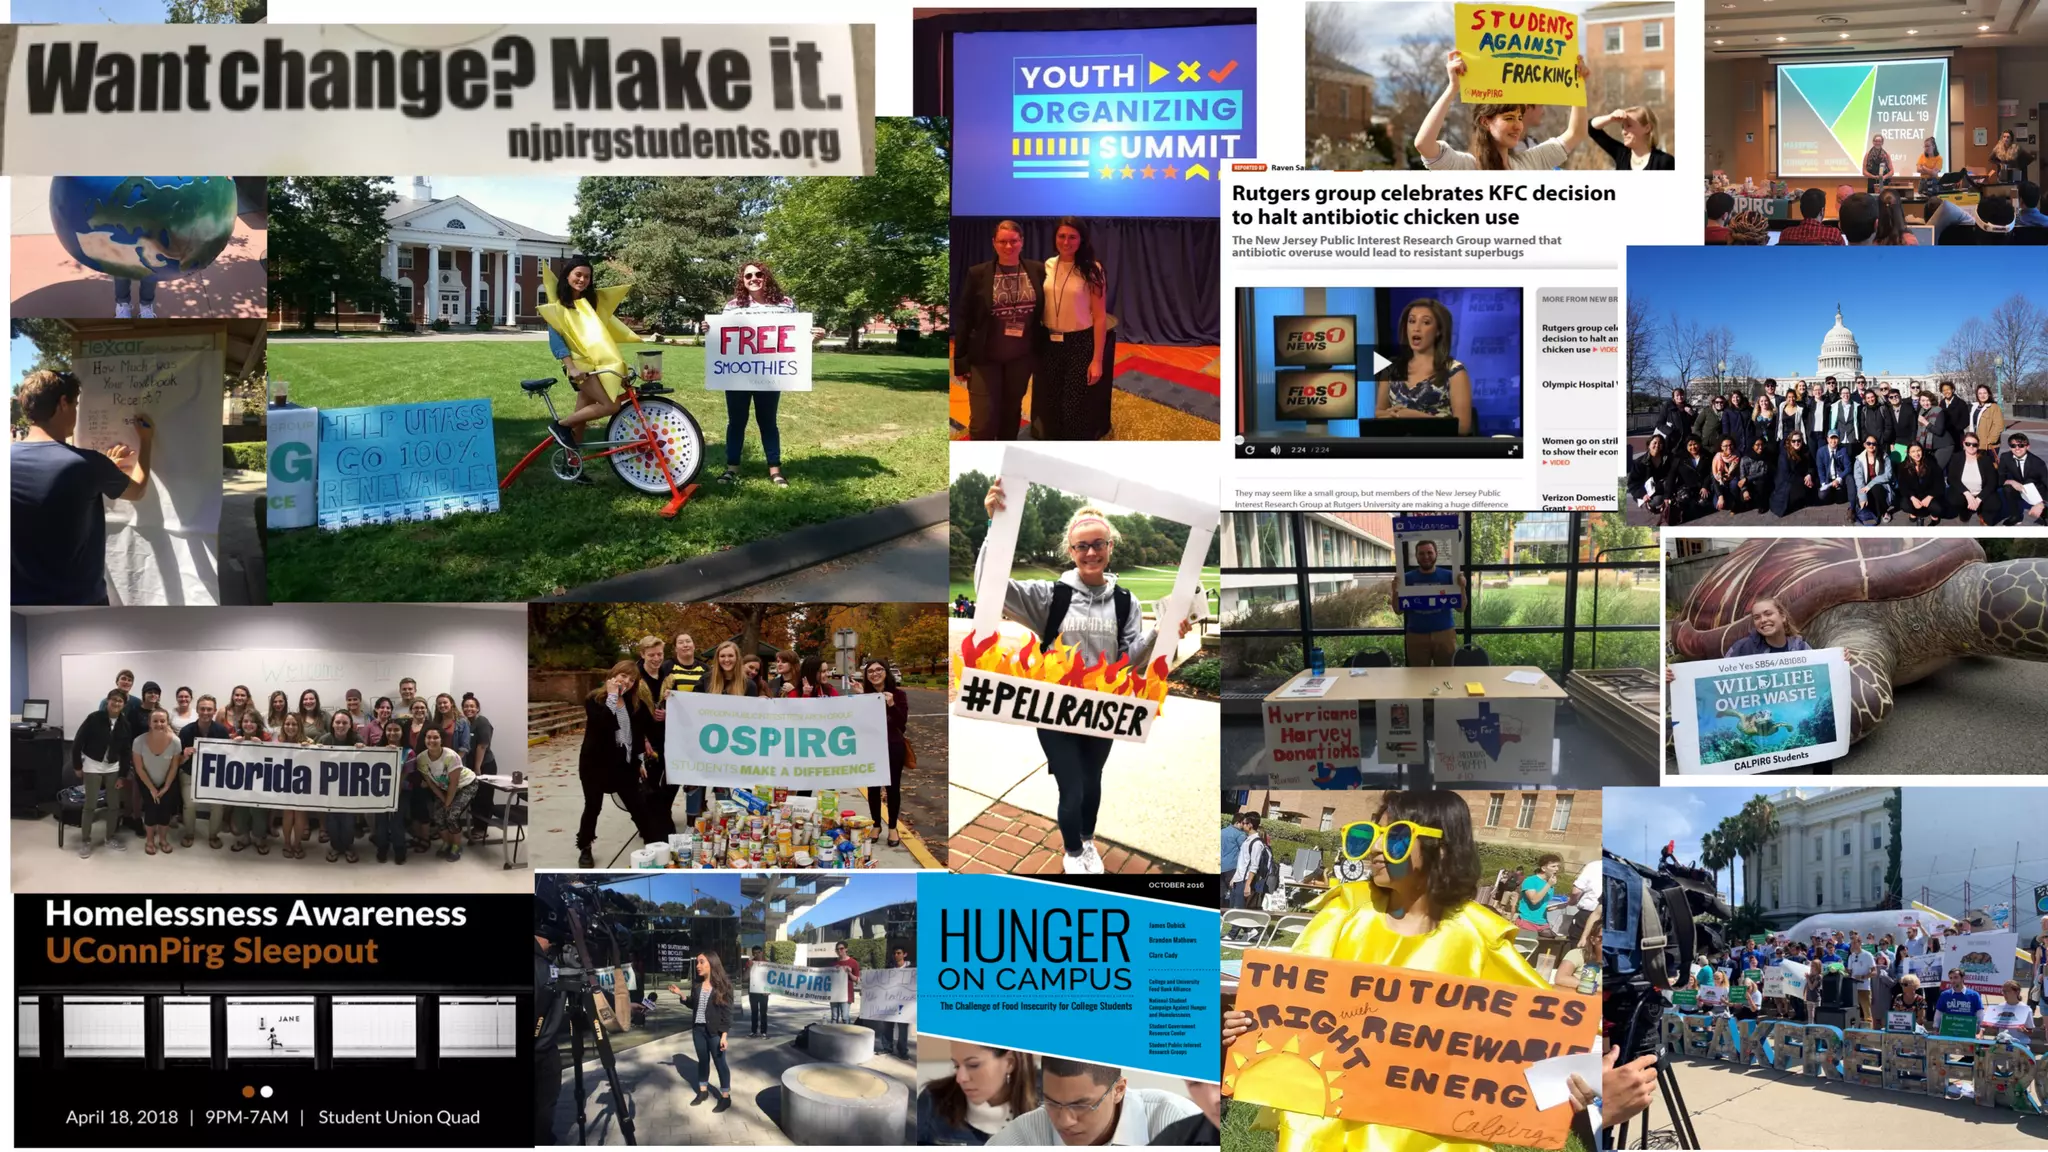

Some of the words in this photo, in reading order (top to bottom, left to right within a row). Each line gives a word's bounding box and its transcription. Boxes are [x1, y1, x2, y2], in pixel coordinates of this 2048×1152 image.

[1471, 9, 1574, 41] STUDENTS
[1479, 32, 1566, 56] AGAINST
[27, 42, 211, 115] Want
[220, 34, 536, 118] change?
[551, 38, 752, 111] Make
[769, 36, 843, 111] it.
[1021, 64, 1134, 89] YOUTH
[1502, 62, 1579, 88] FRACKING!
[1020, 98, 1236, 123] ORGANIZING
[1878, 95, 1928, 106] WELCOME
[1877, 111, 1890, 122] TO
[1891, 111, 1915, 122] FALL
[508, 123, 841, 162] njpirgstudents.org
[1881, 129, 1925, 140] RETREAT
[1099, 135, 1241, 158] SUMMIT
[1233, 185, 1310, 204] Rutgers
[1316, 188, 1376, 204] group
[1381, 184, 1482, 201] celebrates
[1489, 185, 1527, 201] KFC
[1533, 184, 1616, 201] decision
[1232, 211, 1253, 225] to
[1259, 208, 1297, 225] halt
[1302, 208, 1399, 225] antibiotic
[1404, 208, 1479, 225] chicken
[1485, 212, 1520, 225] use
[1232, 236, 1253, 245] The
[1255, 236, 1280, 245] New
[1283, 236, 1317, 247] Jersey
[1320, 236, 1354, 245] Public
[1358, 236, 1400, 245] Interest
[1404, 236, 1453, 245] Research
[1456, 236, 1491, 247] Group
[1494, 236, 1536, 245] warned
[1539, 236, 1562, 245] that
[1232, 248, 1286, 257] antibiotic
[1335, 248, 1370, 257] would
[1372, 248, 1397, 257] lead
[1399, 249, 1411, 257] to
[1413, 248, 1462, 257] resistant
[1465, 248, 1524, 259] superbugs
[720, 325, 795, 355] FREE
[1542, 325, 1575, 333] Rutgers
[1287, 342, 1326, 350] NEWS
[714, 360, 798, 375] SMOOTHIES
[1542, 381, 1577, 389] Olympic
[1579, 381, 1614, 389] Hospital
[1287, 397, 1327, 405] NEWS
[321, 409, 398, 442] HELP
[405, 405, 488, 435] UMASS
[336, 446, 387, 475] GO
[400, 435, 481, 469] 100%
[322, 463, 494, 509] RENEWABLE!
[1235, 490, 1253, 498] They
[1454, 490, 1476, 498] Jersey
[1718, 665, 1738, 673] Vote
[1738, 662, 1753, 671] Yes
[1755, 656, 1807, 668] SB54/AB1080
[1713, 669, 1815, 695] WILDLIFE
[961, 676, 1148, 736] #PELLRAISER
[1716, 694, 1760, 711] OVER
[1763, 687, 1817, 705] WASTE
[1268, 706, 1357, 723] Hurricane
[699, 724, 856, 757] OSPIRG
[1281, 727, 1352, 746] Harvey
[1273, 741, 1360, 762] Donations
[1734, 756, 1771, 771] CALPIRG
[1773, 751, 1809, 763] Students
[200, 753, 311, 795] Florida
[320, 761, 392, 797] PIRG
[671, 761, 738, 773] STUDENTS
[740, 765, 776, 777] MAKE
[780, 767, 790, 777] A
[793, 763, 876, 777] DIFFERENCE
[46, 900, 278, 926] Homelessness
[286, 900, 467, 926] Awareness
[941, 908, 1130, 963] HUNGER
[47, 937, 225, 969] UConnPirg
[234, 937, 378, 969] Sleepout
[767, 970, 832, 992] CALPIRG
[938, 967, 984, 990] ON
[996, 967, 1132, 990] CAMPUS
[1246, 962, 1329, 994] THE
[1350, 975, 1517, 1018] FUTURE
[1528, 994, 1587, 1027] IS
[940, 1001, 953, 1010] The
[955, 1001, 990, 1012] Challenge
[992, 1001, 1000, 1010] of
[1002, 1001, 1019, 1010] Food
[1021, 1001, 1057, 1012] Insecurity
[1059, 1001, 1069, 1010] for
[1071, 1001, 1098, 1012] College
[1100, 1001, 1132, 1010] Students
[66, 1110, 104, 1129] April
[109, 1111, 134, 1128] 18,
[137, 1111, 179, 1125] 2018
[205, 1111, 289, 1125] 9PM-7AM
[319, 1110, 381, 1125] Student
[387, 1110, 431, 1125] Union
[437, 1110, 481, 1127] Quad
